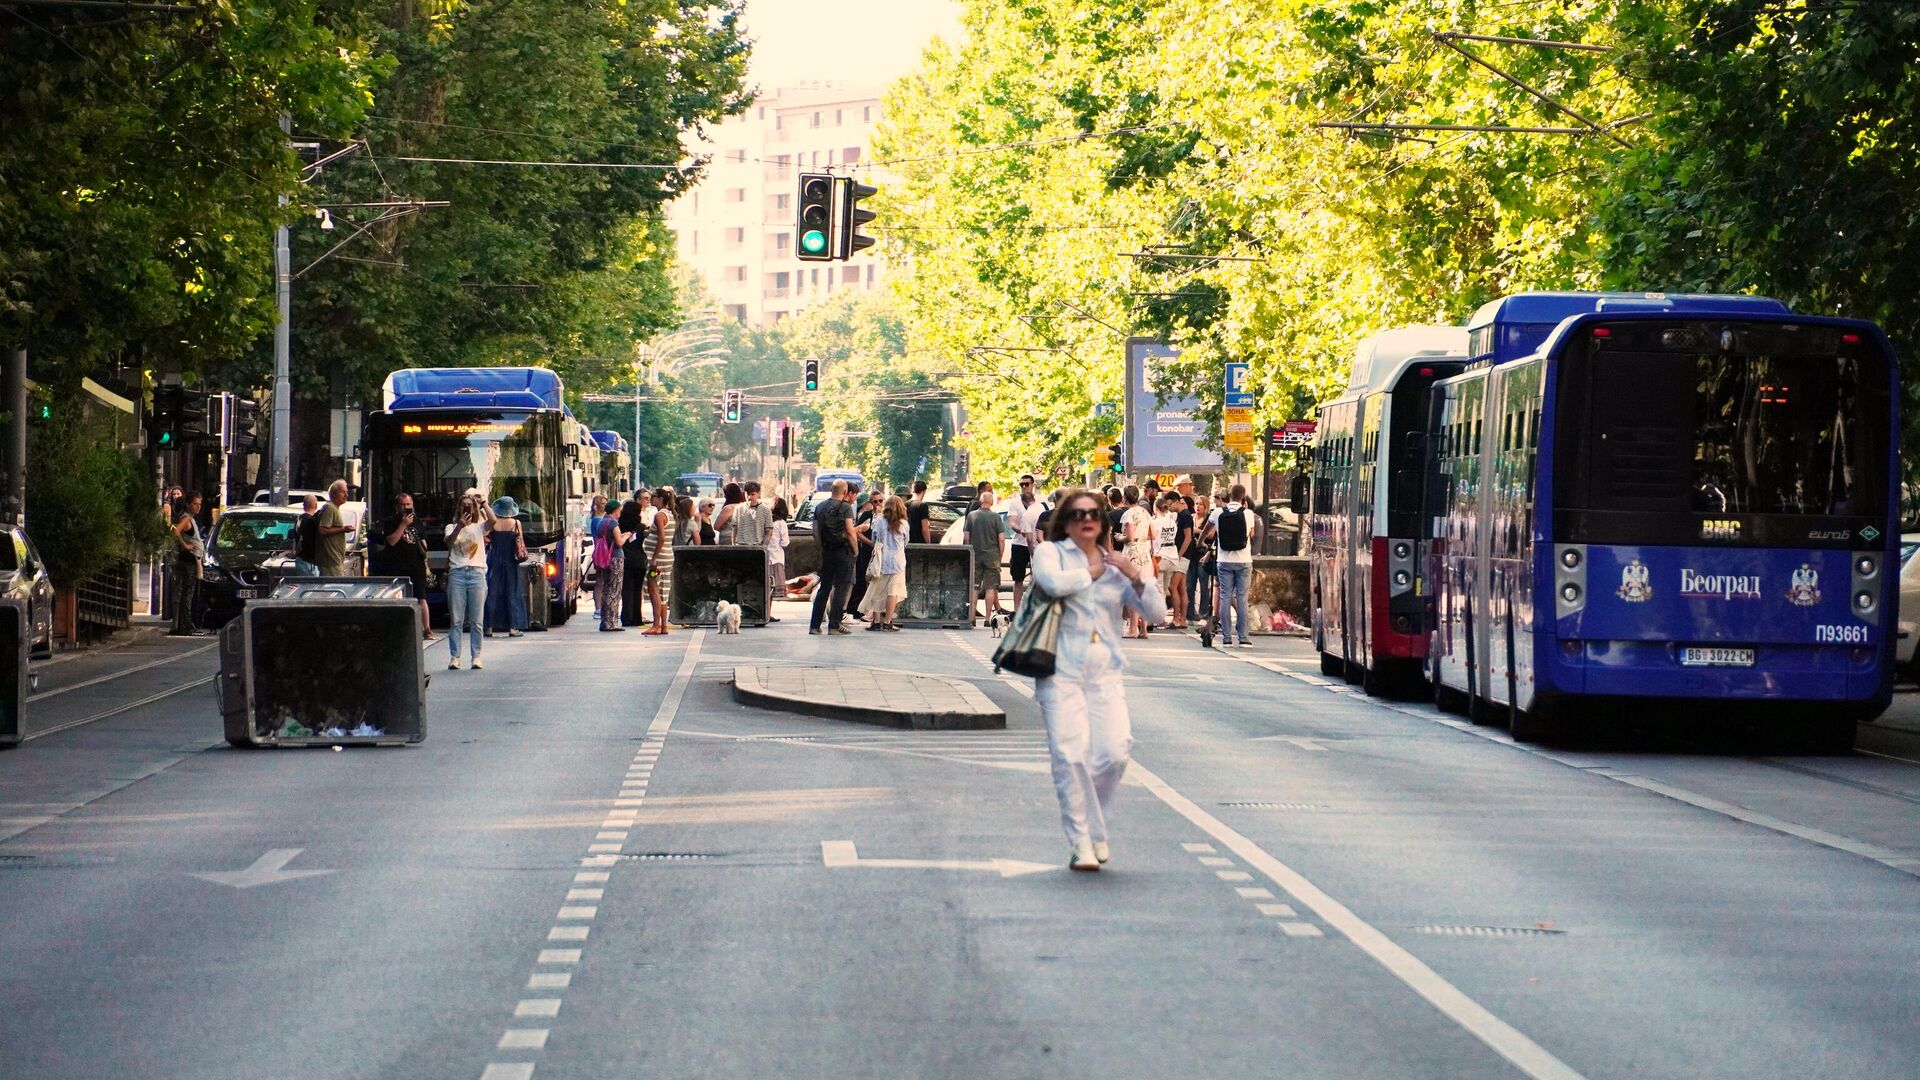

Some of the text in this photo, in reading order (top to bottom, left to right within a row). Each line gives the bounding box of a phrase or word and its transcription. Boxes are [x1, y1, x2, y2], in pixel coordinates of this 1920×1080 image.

[1156, 424, 1194, 433] konobar
[1160, 475, 1174, 487] 20
[1702, 520, 1741, 538] BMC
[1680, 568, 1761, 600] Београд
[1815, 625, 1868, 642] П93661
[1688, 649, 1701, 660] BG
